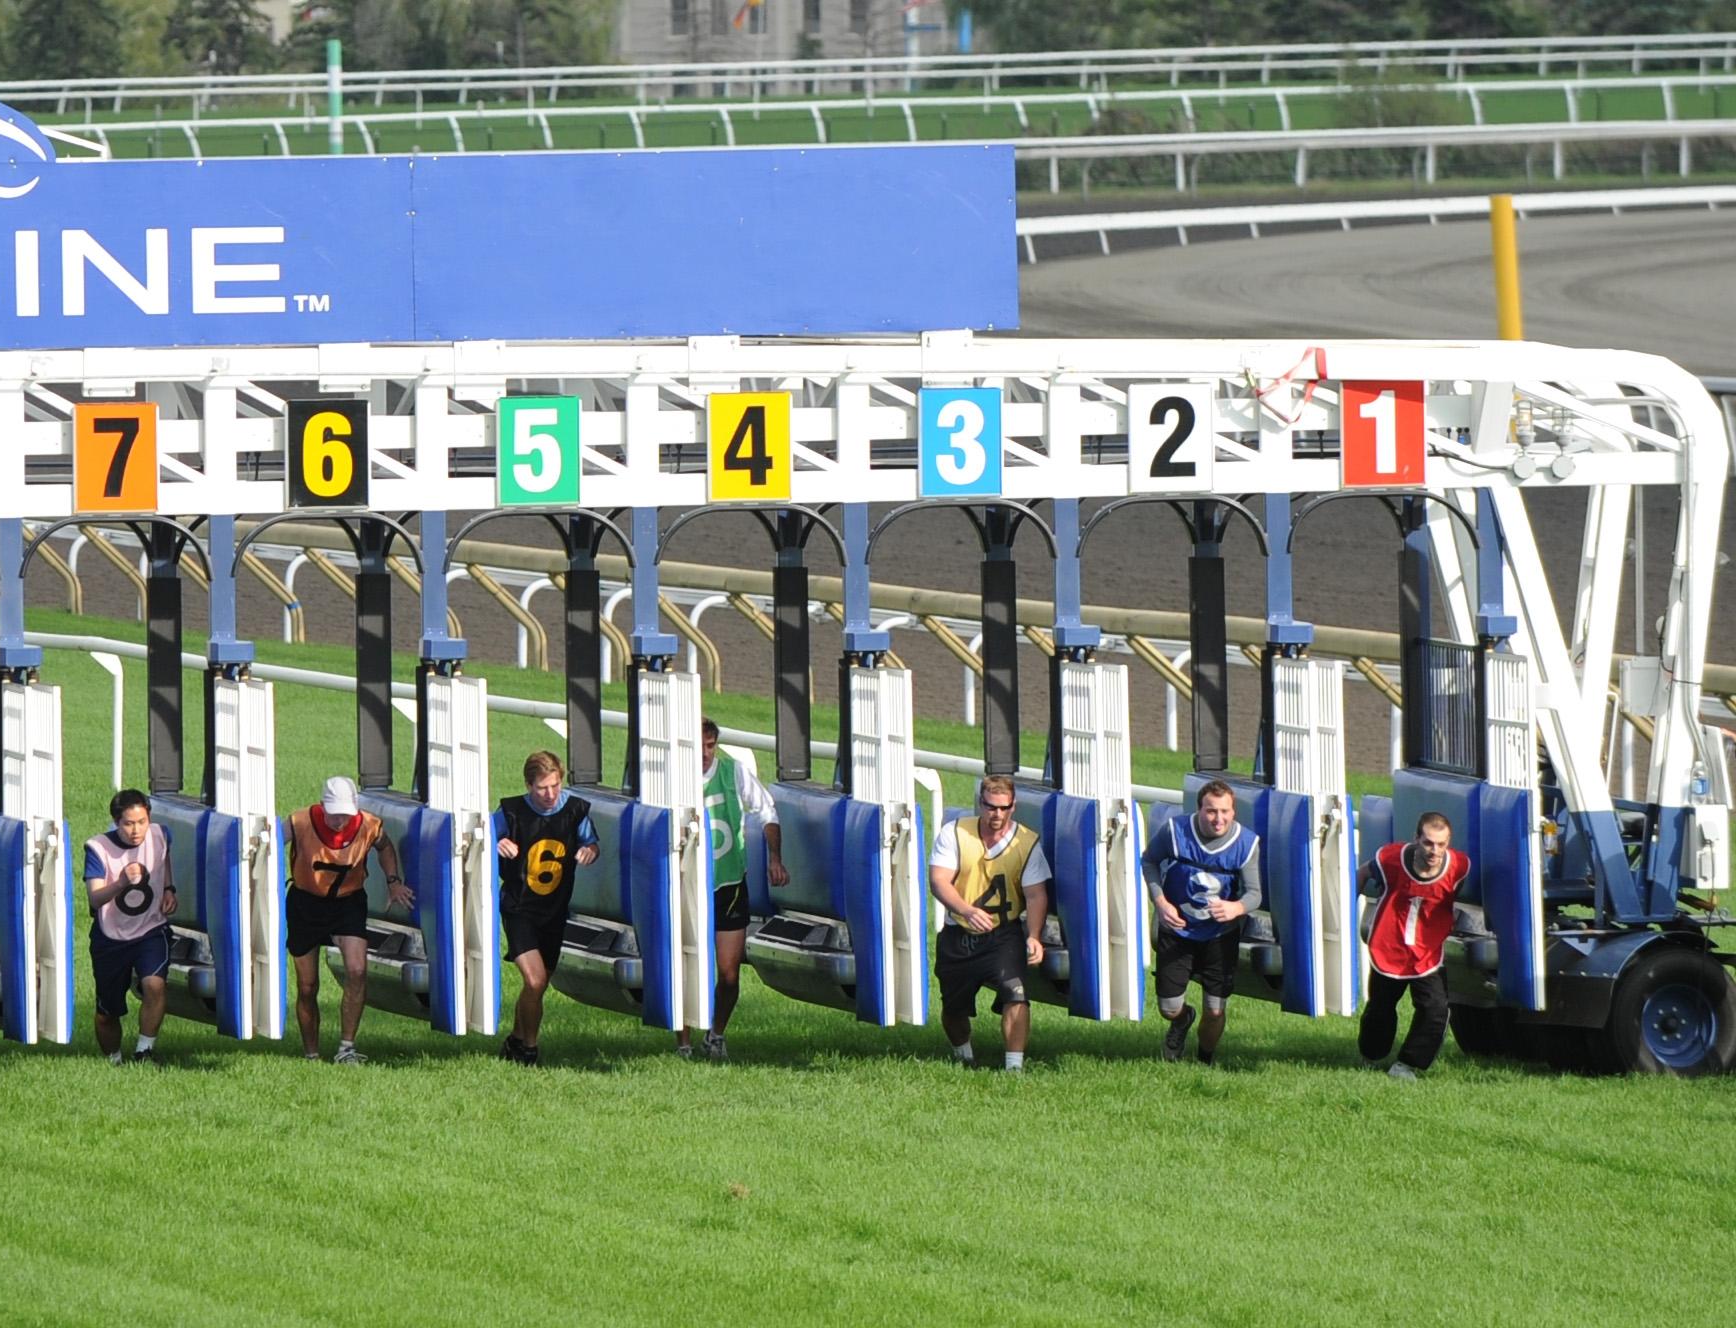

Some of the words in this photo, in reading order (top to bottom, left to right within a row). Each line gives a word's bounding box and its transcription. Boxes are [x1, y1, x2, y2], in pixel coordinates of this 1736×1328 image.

[293, 294, 330, 312] TM
[92, 418, 140, 498] 7
[301, 411, 353, 497] 6
[512, 408, 562, 493] 5
[723, 406, 773, 486] 4
[935, 399, 986, 486] 3
[1149, 396, 1196, 478] 2
[1360, 390, 1398, 474] 1
[115, 862, 155, 917] 8
[313, 861, 354, 897] 7
[527, 839, 566, 896] 6
[973, 873, 1012, 927] 4
[1404, 896, 1423, 946] 1
